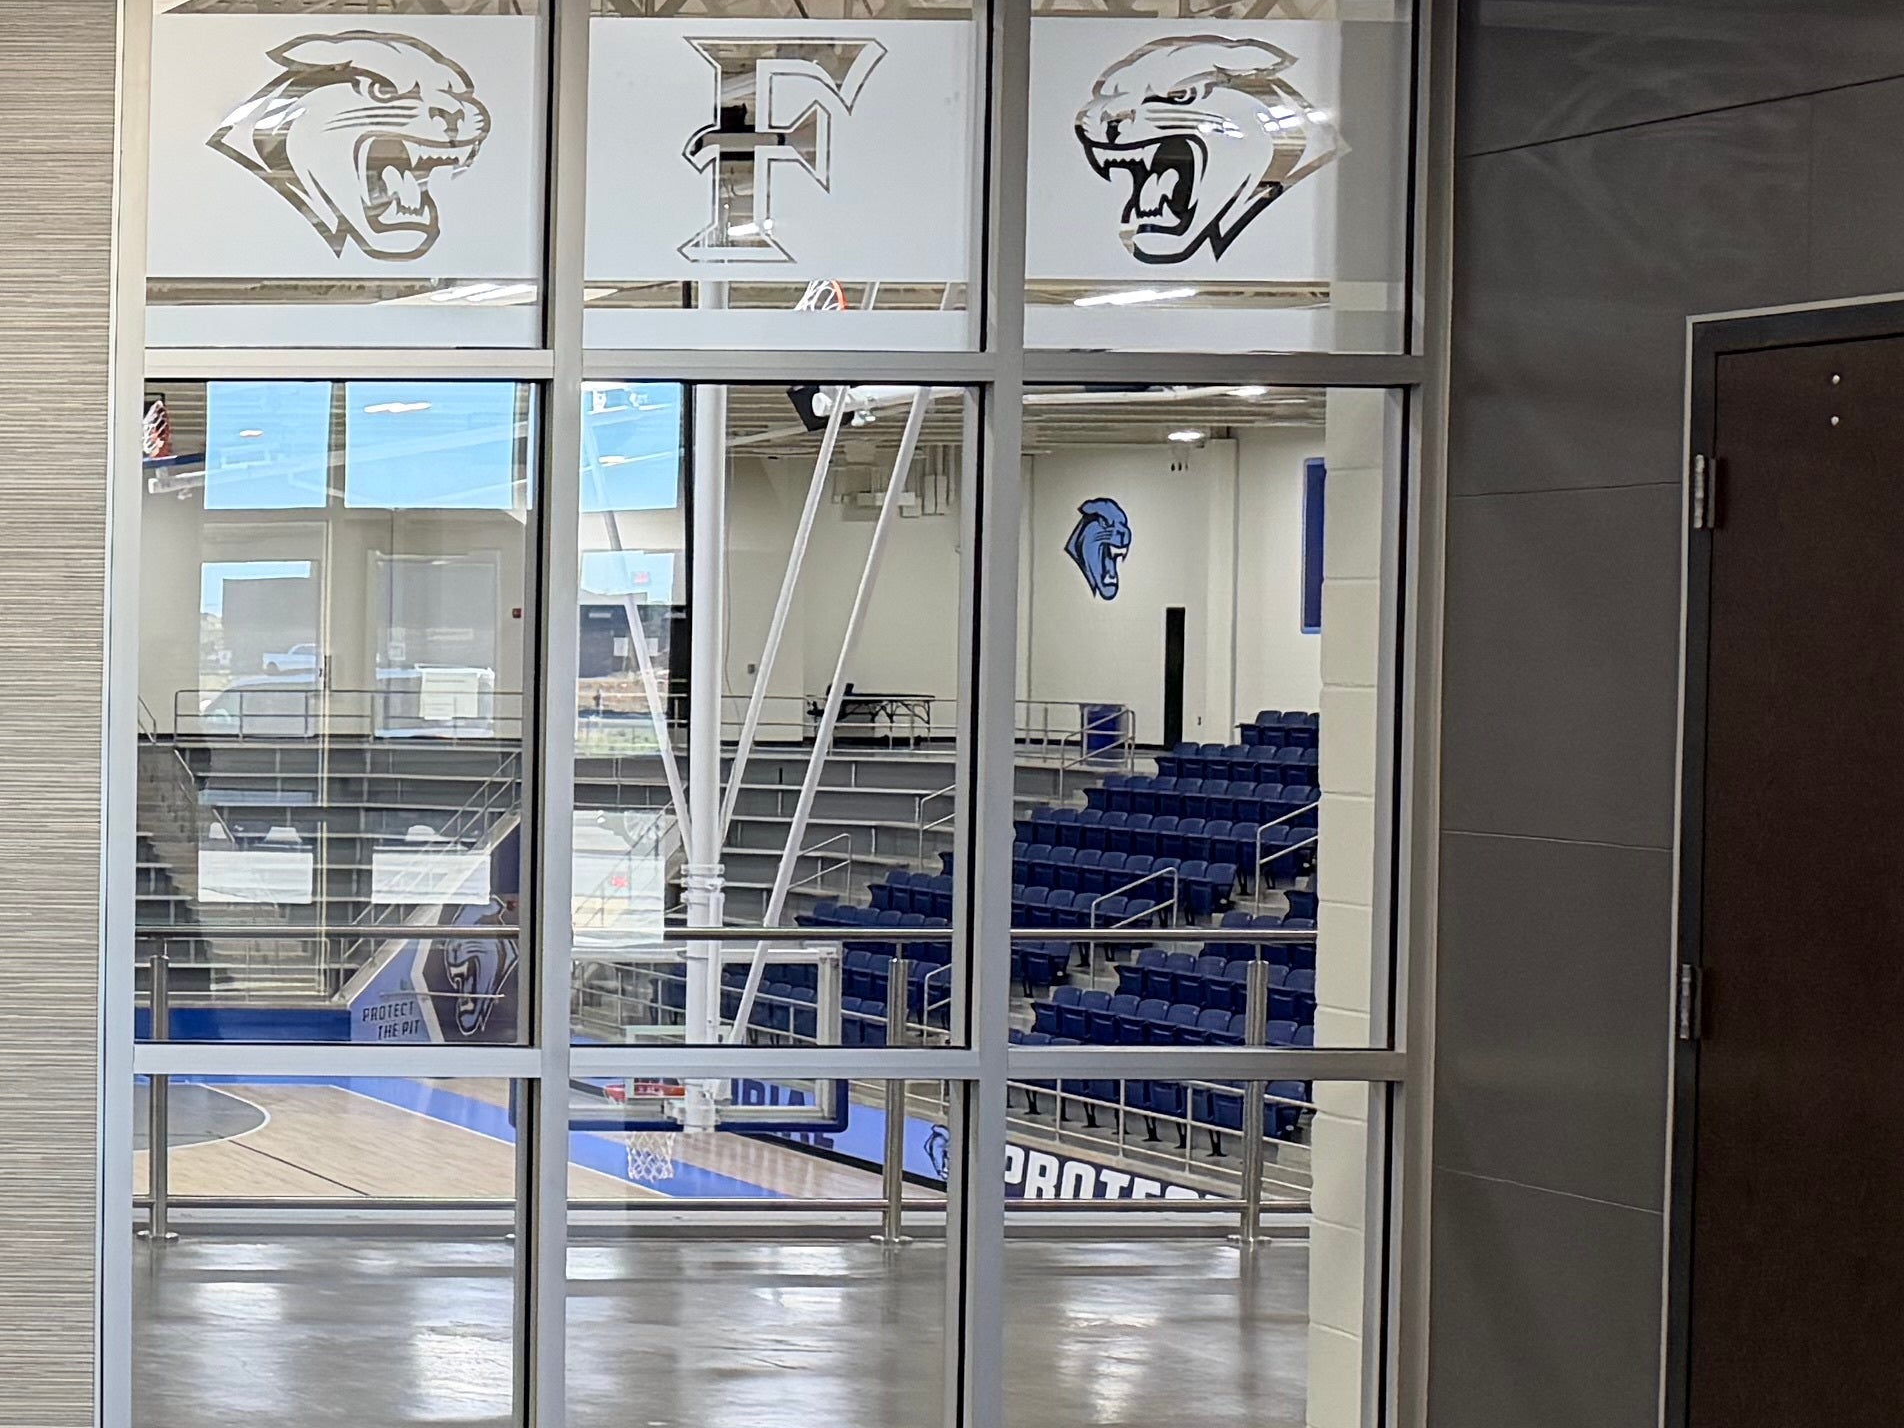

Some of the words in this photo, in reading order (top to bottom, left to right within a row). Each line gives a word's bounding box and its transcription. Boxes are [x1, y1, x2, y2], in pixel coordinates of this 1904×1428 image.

[677, 35, 889, 263] F
[362, 1001, 414, 1022] PROTECT
[378, 1023, 400, 1040] THE
[401, 1020, 421, 1035] PIT
